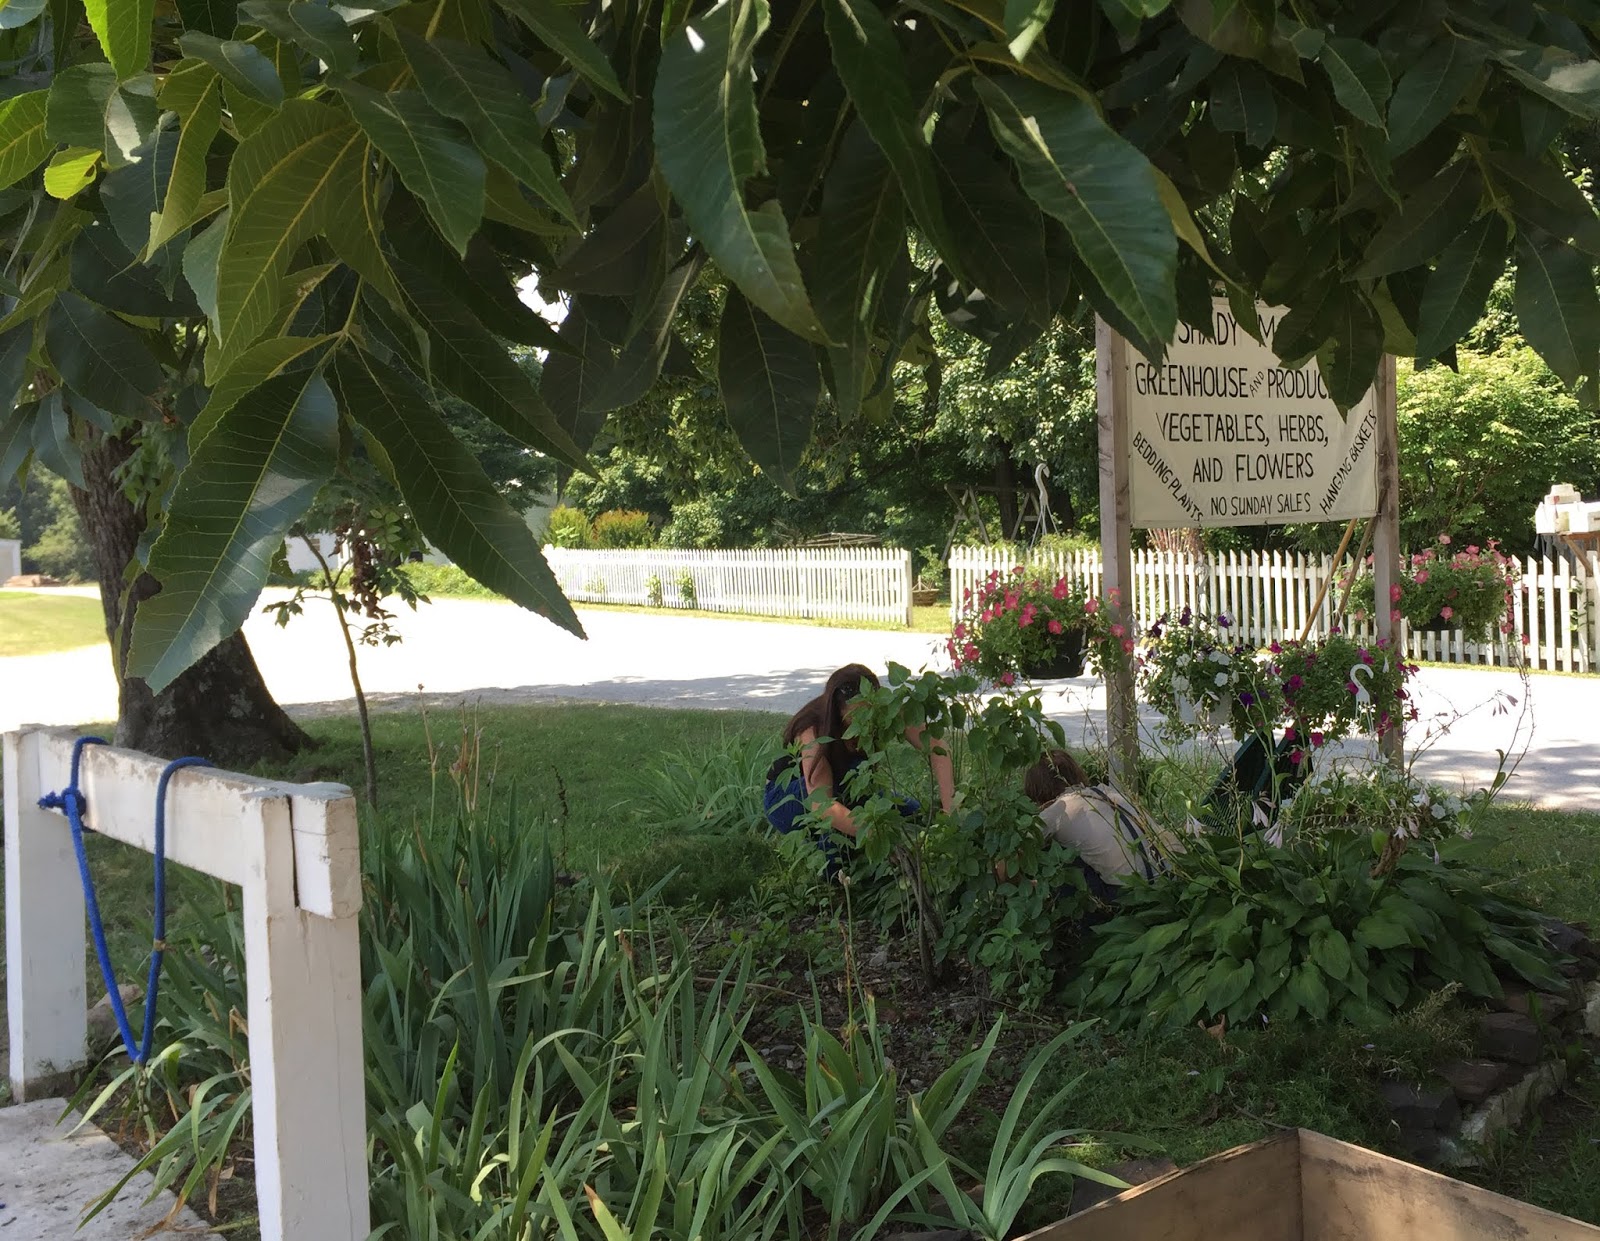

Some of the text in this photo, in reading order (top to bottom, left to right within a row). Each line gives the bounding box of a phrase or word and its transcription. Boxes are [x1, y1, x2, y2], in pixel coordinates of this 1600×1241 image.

[1135, 362, 1332, 399] GREENHOUSE AND PRODUC
[1156, 412, 1329, 447] VEGETABLES, HERBS,
[1132, 431, 1204, 522] BEDDING PLANTS
[1192, 452, 1314, 483] AND FLOWERS
[1319, 409, 1377, 515] HANGING BASKETS
[1210, 492, 1311, 516] NO SUNDAY SALES
